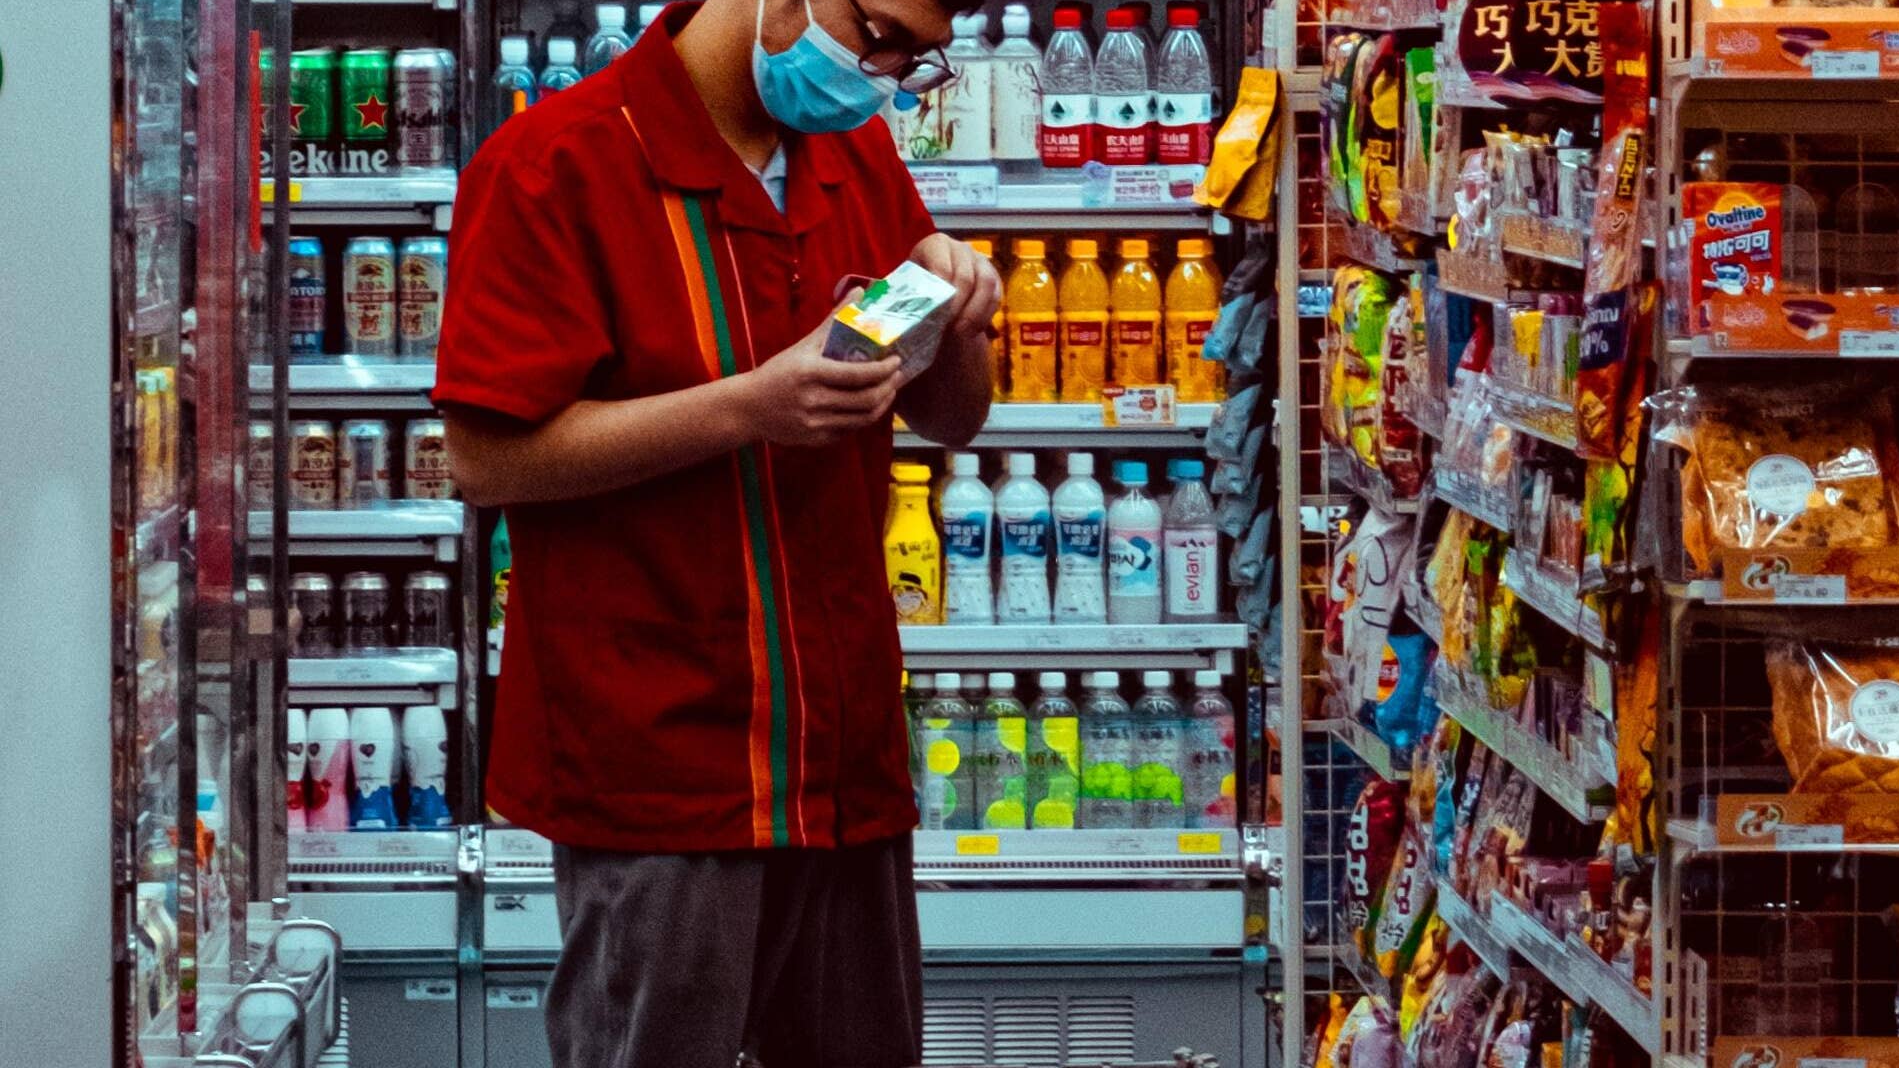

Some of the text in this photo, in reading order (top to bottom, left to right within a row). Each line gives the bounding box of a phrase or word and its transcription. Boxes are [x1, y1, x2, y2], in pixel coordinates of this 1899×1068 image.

[1525, 0, 1600, 37] 巧克
[1706, 205, 1766, 229] Ovaltine
[1186, 550, 1201, 602] evian
